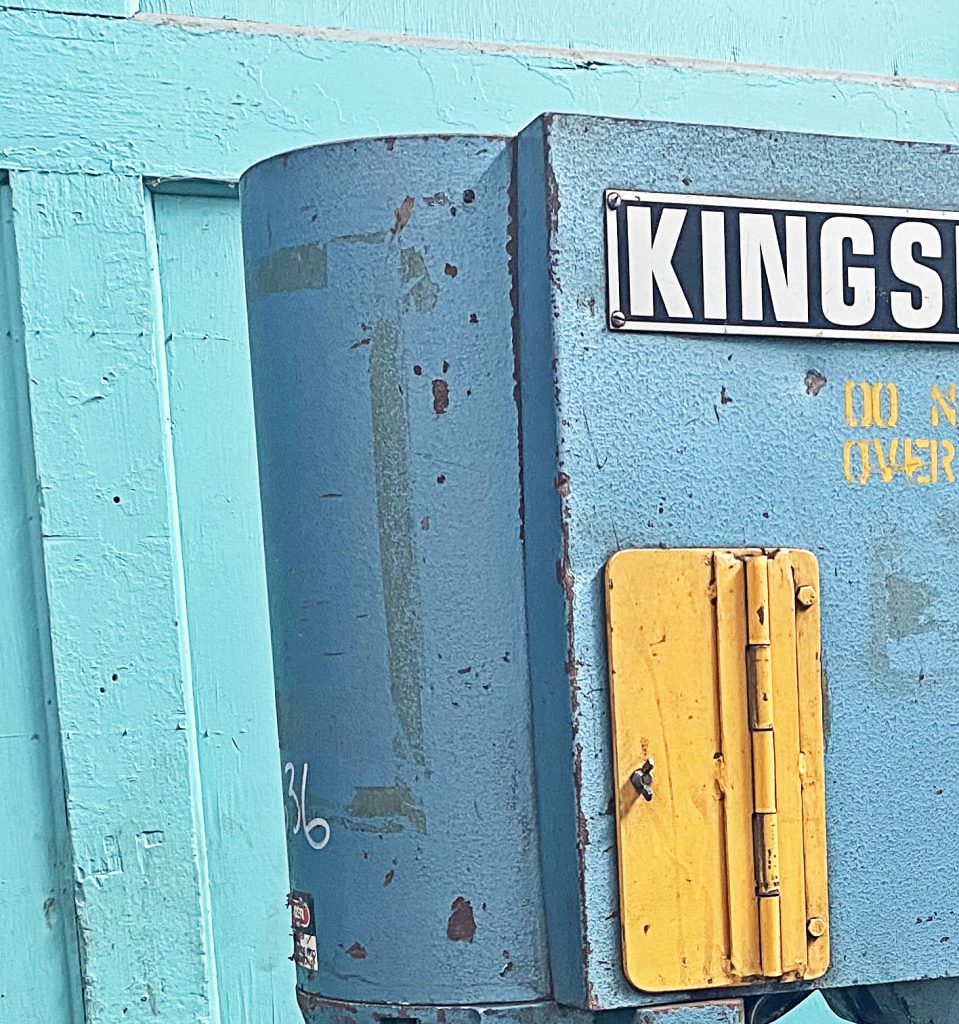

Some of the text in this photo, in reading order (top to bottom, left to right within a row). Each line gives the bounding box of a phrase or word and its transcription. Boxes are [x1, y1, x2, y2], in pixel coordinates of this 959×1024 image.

[844, 380, 898, 427] DO
[843, 438, 955, 485] OVER
[284, 762, 330, 850] 36
